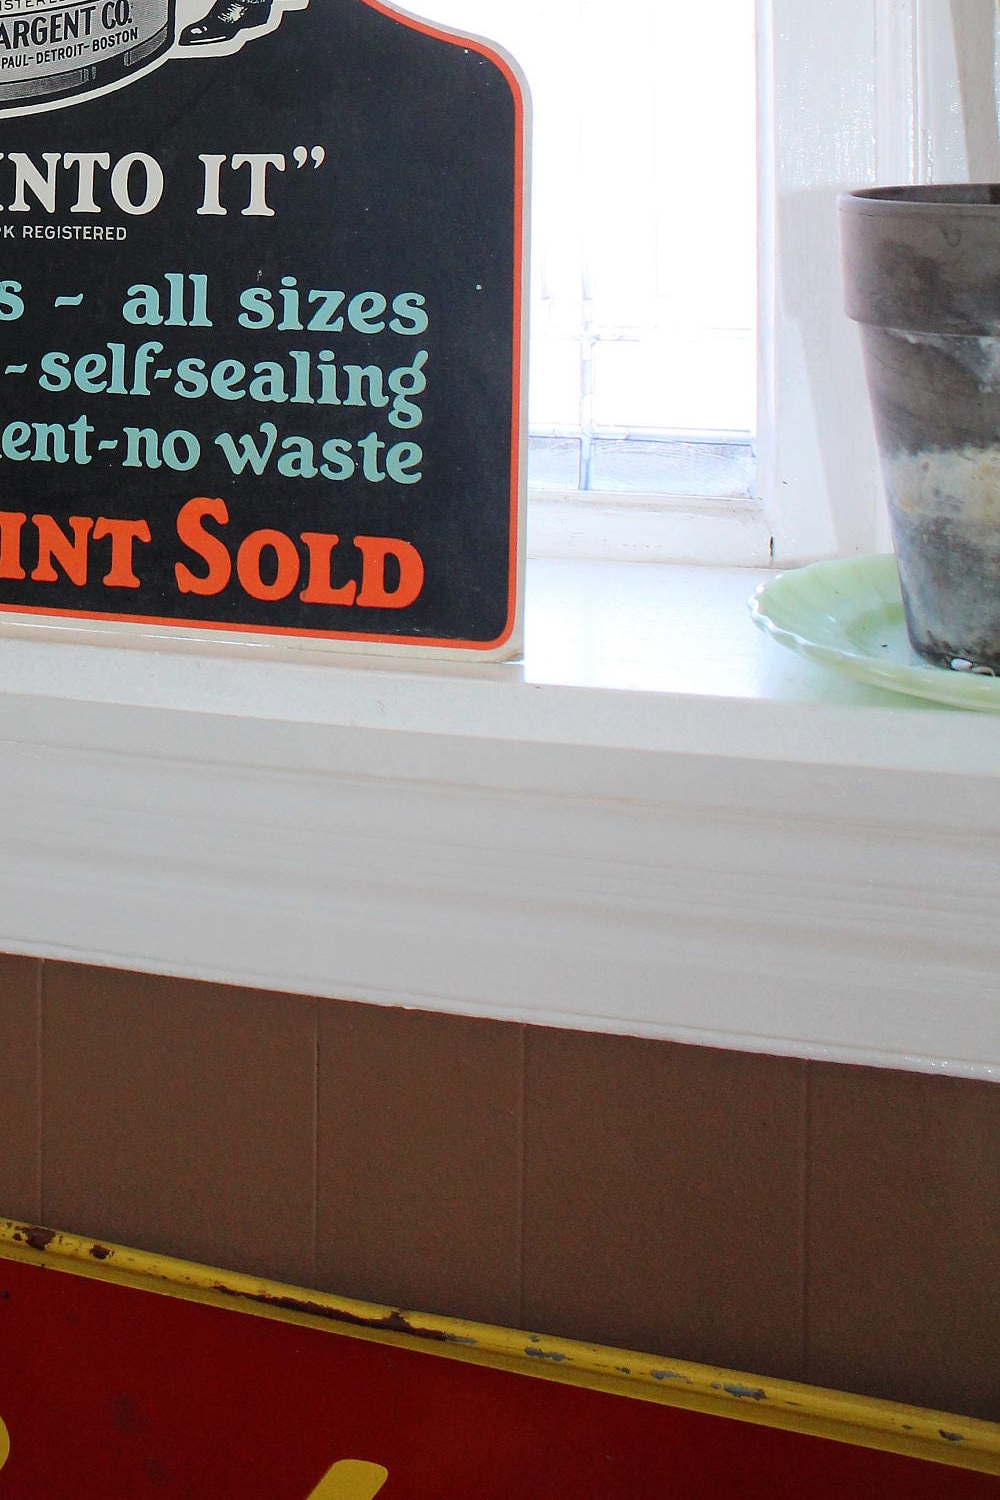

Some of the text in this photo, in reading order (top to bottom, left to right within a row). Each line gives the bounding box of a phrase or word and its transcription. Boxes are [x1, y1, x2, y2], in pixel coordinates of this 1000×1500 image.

[22, 225, 128, 241] REGISTERED
[122, 273, 213, 327] all
[237, 276, 430, 335] sizes
[38, 341, 430, 429] self-sealing
[214, 421, 424, 485] waste
[175, 496, 425, 609] SOLD
